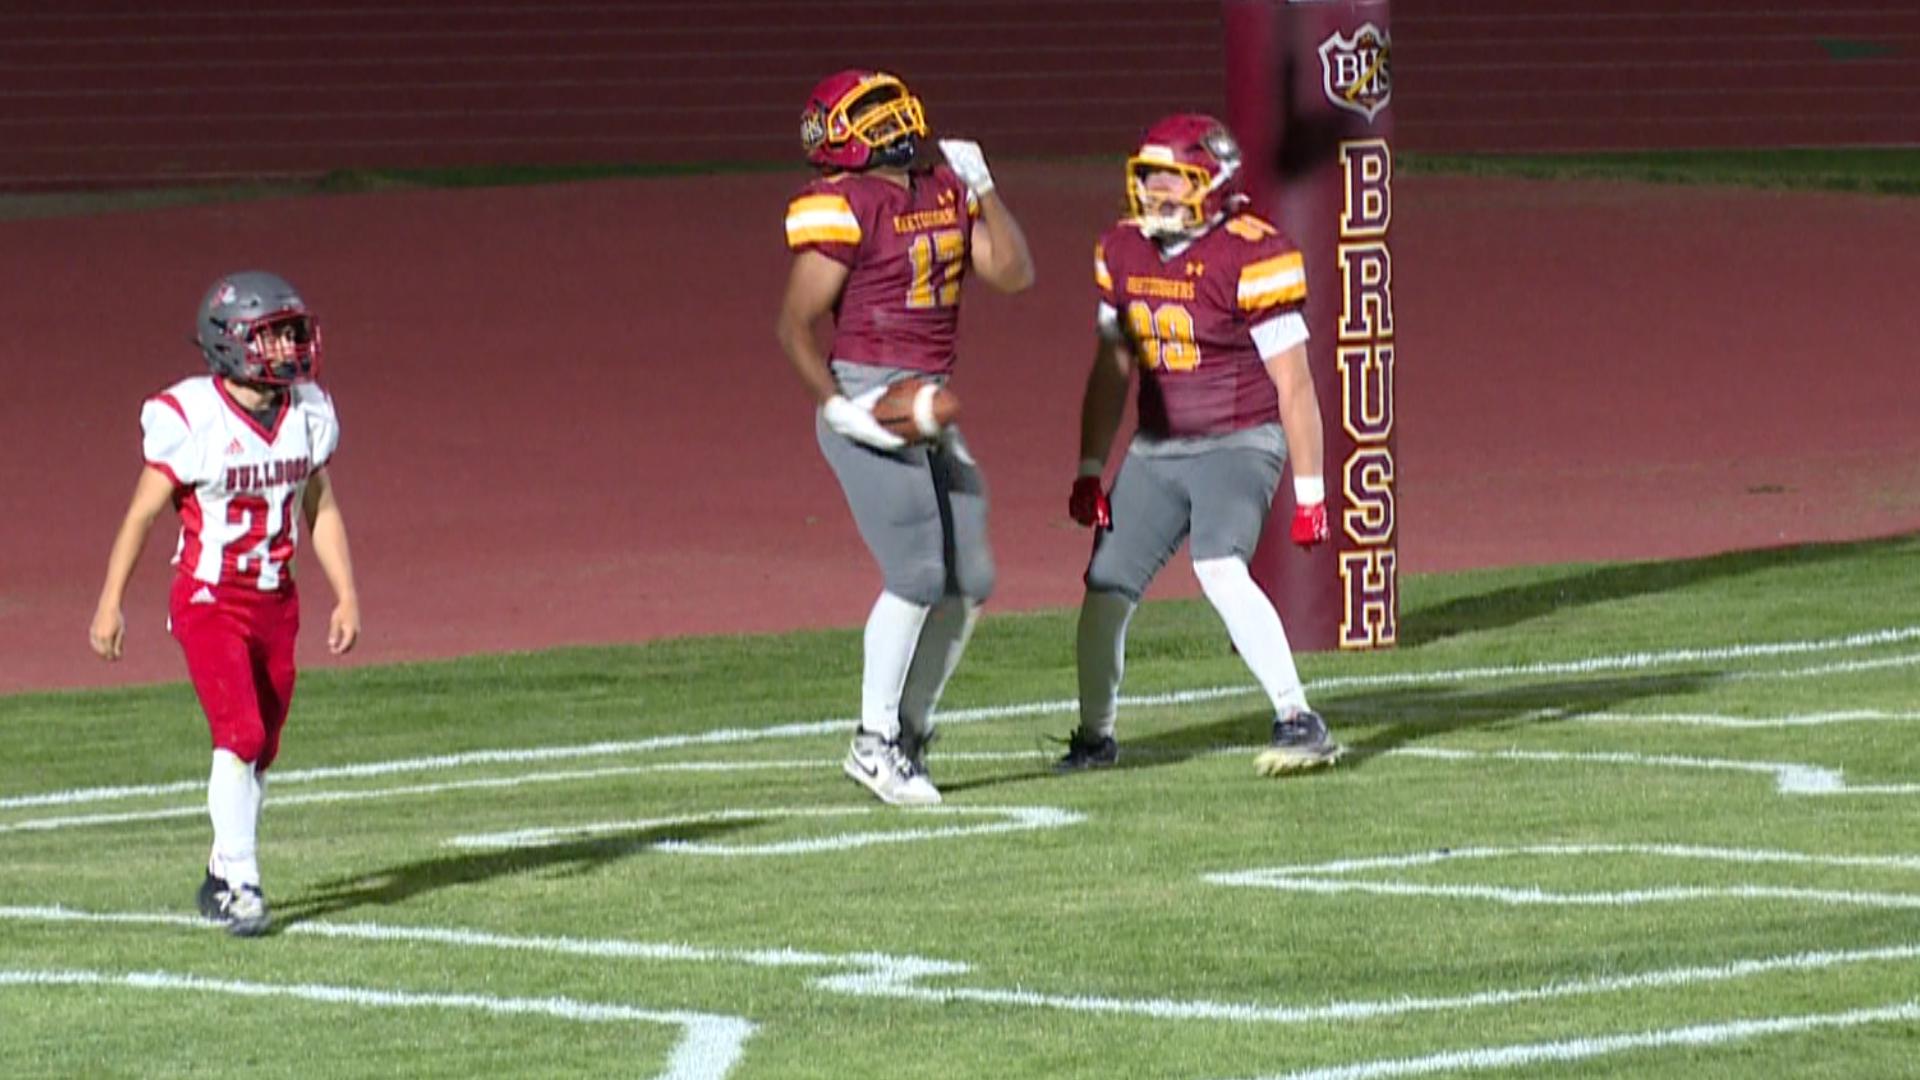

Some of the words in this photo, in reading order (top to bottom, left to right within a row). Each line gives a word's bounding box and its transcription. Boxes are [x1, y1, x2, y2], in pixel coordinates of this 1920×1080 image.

[1334, 48, 1390, 95] BHS
[906, 229, 964, 309] 17
[1337, 138, 1397, 649] BRUSH
